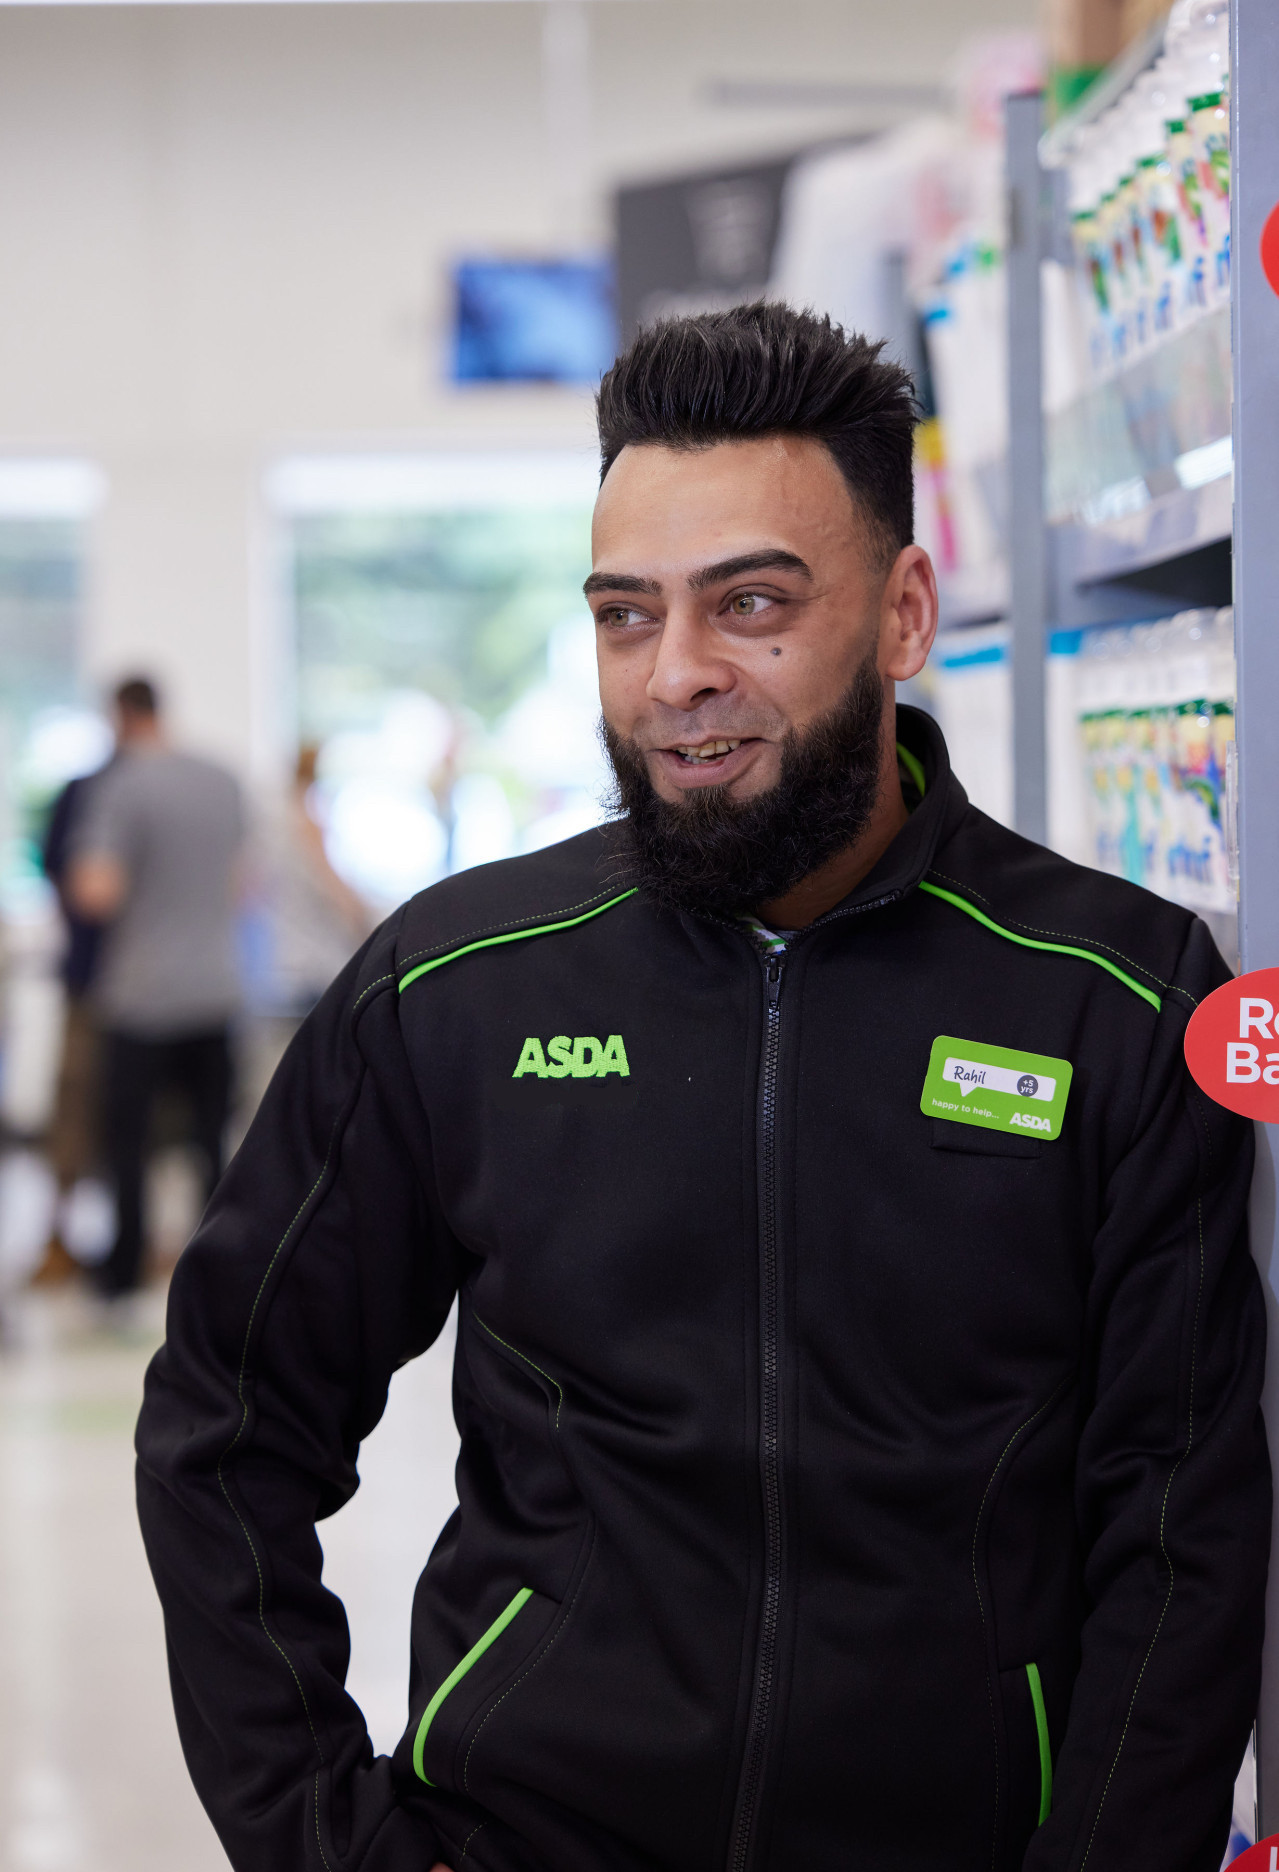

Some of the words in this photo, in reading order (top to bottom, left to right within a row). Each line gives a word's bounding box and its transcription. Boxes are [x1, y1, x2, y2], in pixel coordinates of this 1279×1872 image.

[1239, 997, 1279, 1039] R
[511, 1034, 631, 1078] ASDA
[953, 1065, 987, 1085] Rahil
[1020, 1085, 1034, 1094] yrs
[931, 1097, 960, 1112] happy
[961, 1104, 971, 1113] to
[1009, 1111, 1052, 1133] ASDA
